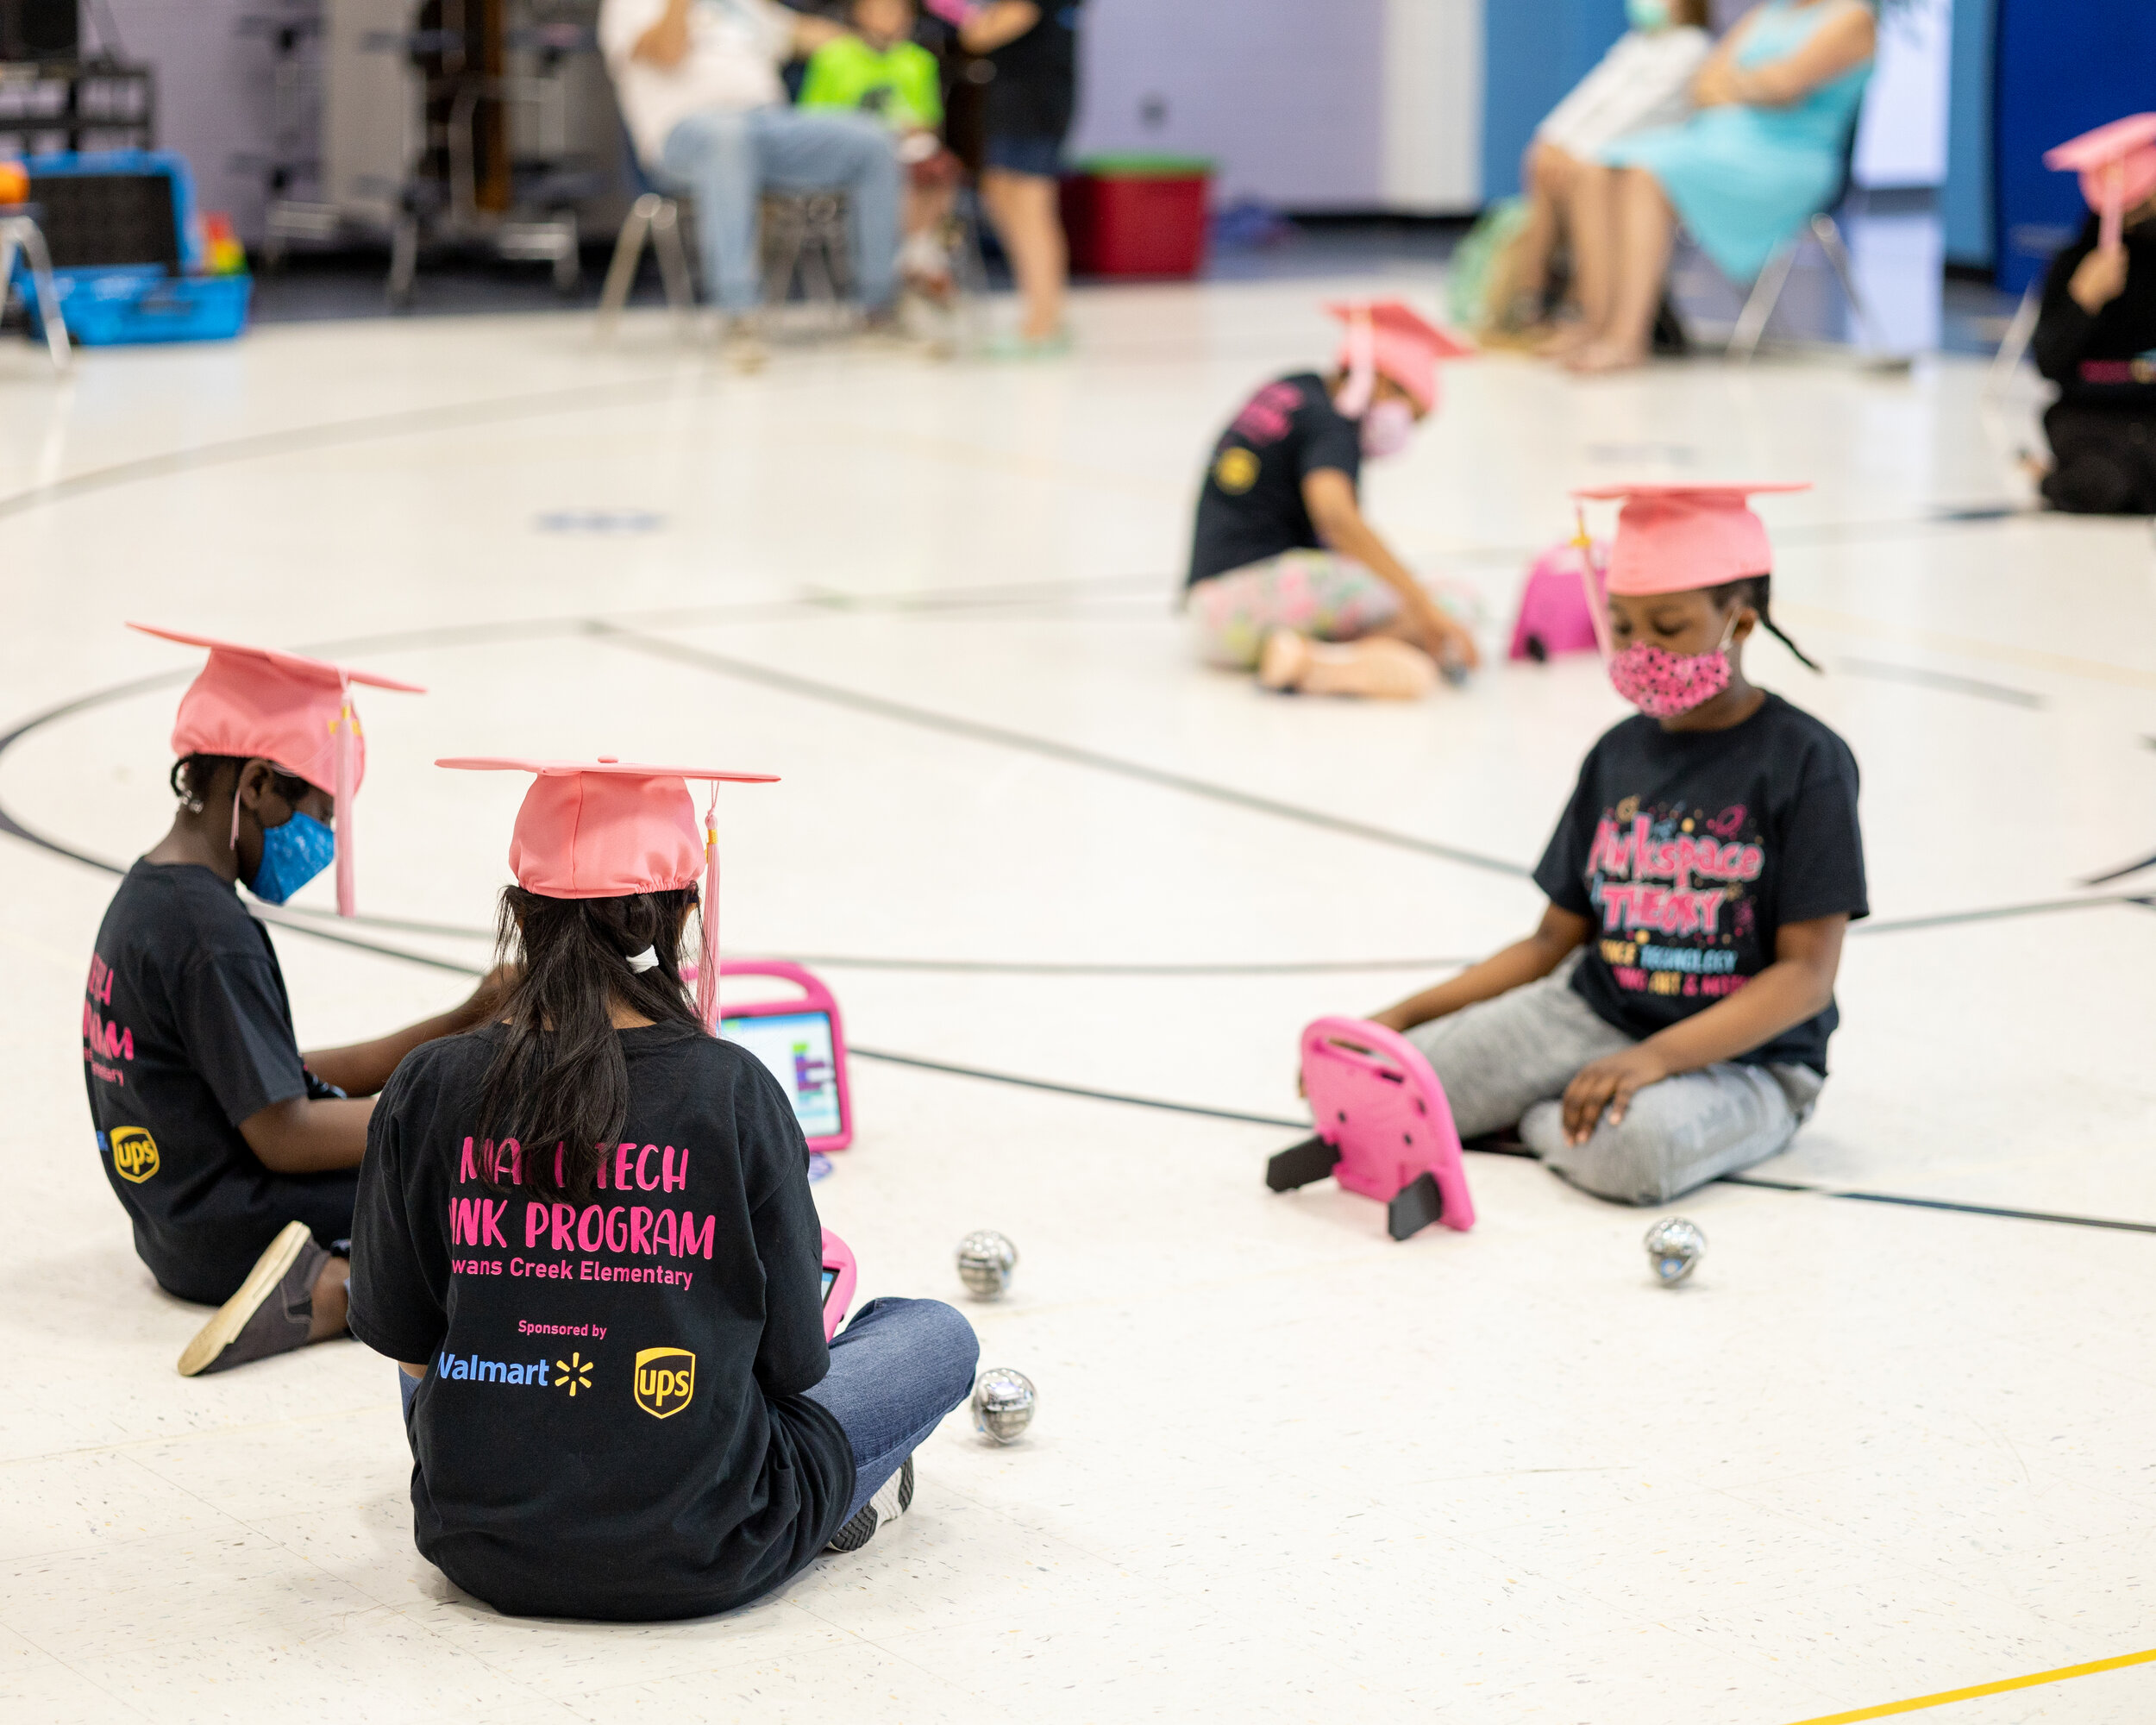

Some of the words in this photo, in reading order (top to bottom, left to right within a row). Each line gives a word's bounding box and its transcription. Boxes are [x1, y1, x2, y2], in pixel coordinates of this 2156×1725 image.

[1601, 881, 1727, 937] THEORY
[1640, 944, 1739, 975] TECHNOLOGY
[116, 1140, 157, 1175] ups
[594, 1142, 689, 1193] TECH
[448, 1196, 507, 1248] INK
[525, 1201, 716, 1260] PROGRAM
[451, 1258, 503, 1276] wans
[510, 1258, 573, 1280] Creek
[580, 1261, 693, 1291] Elementary
[517, 1320, 588, 1337] Sponsored
[592, 1324, 607, 1340] by
[638, 1369, 690, 1407] ups
